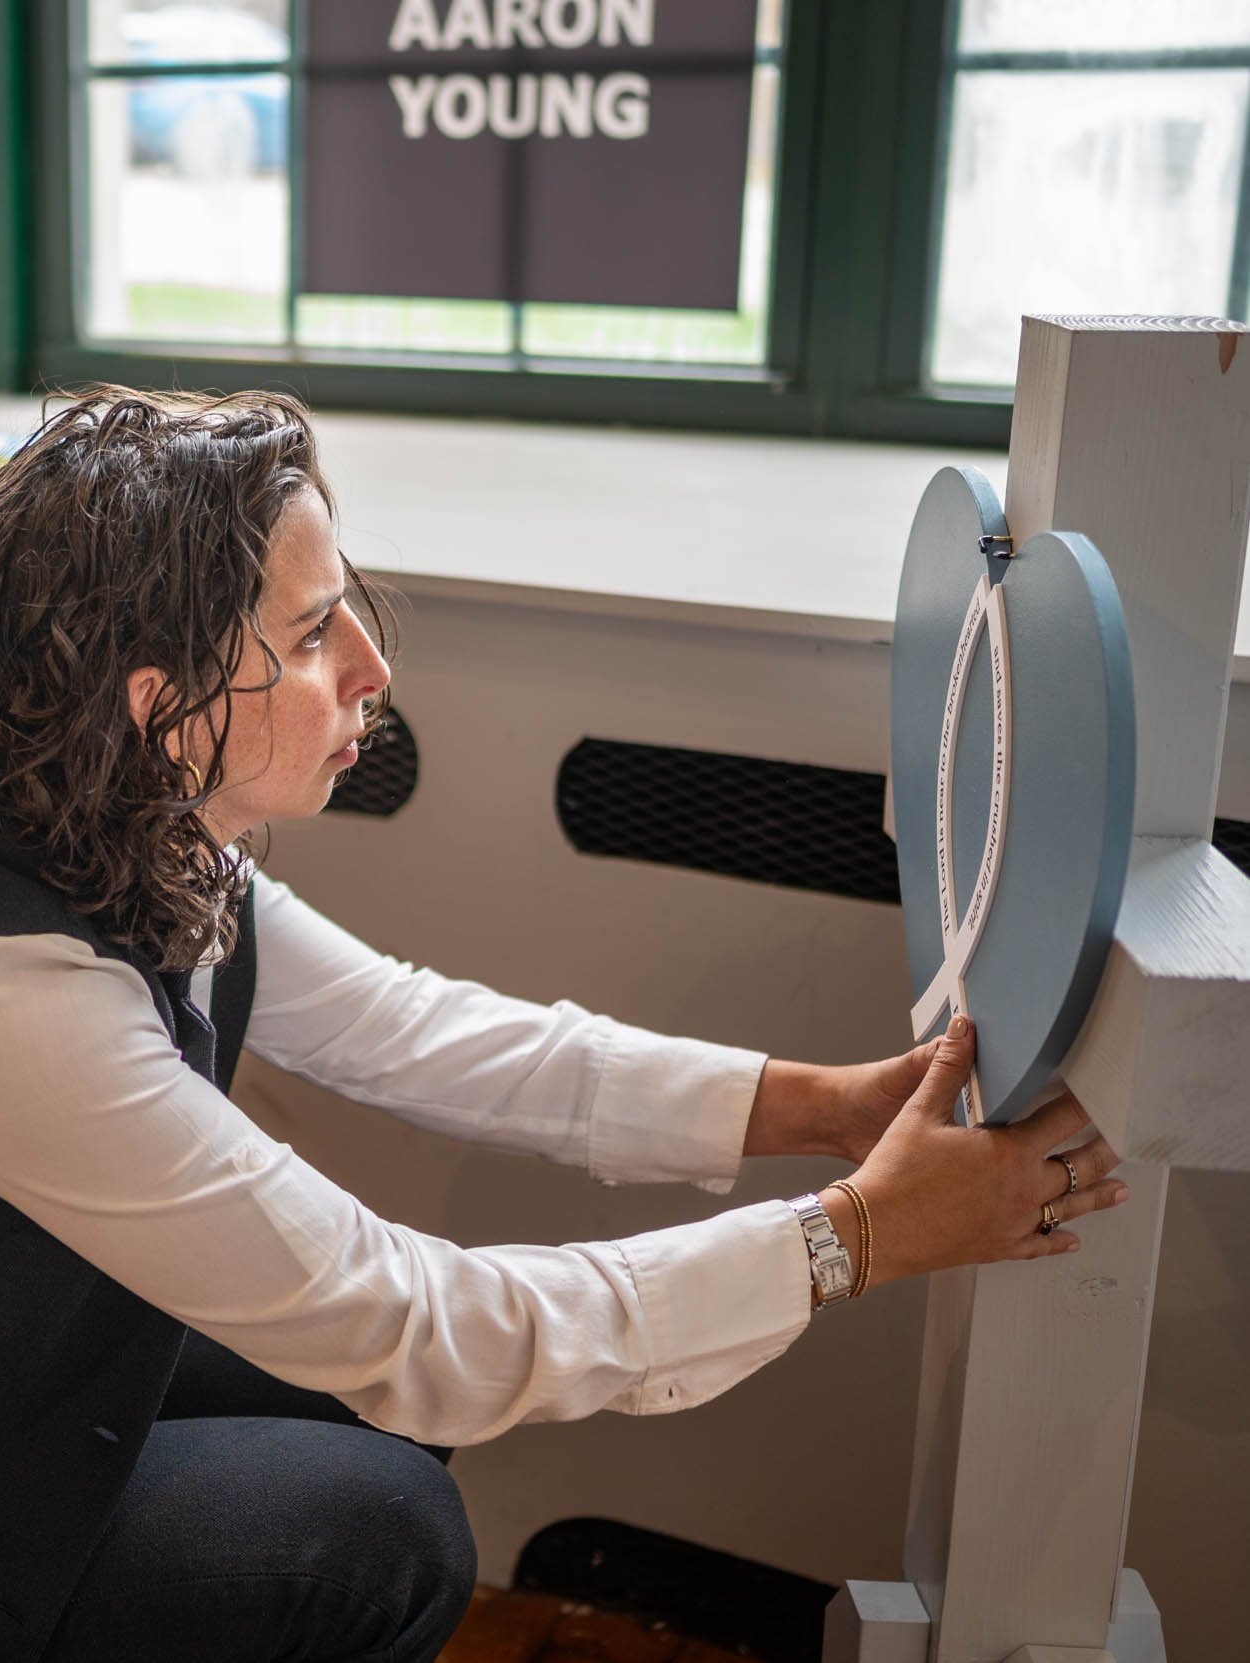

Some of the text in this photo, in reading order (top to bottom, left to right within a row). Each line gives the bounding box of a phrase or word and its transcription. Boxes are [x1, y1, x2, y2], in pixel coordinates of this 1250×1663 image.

[388, 0, 654, 50] AARON
[388, 72, 650, 139] YOUNG
[994, 645, 1002, 684] and
[939, 847, 947, 895] Lord
[943, 718, 951, 750] the
[947, 597, 981, 716] brokenhearted
[995, 751, 1003, 785] the
[986, 789, 1000, 873] crushed
